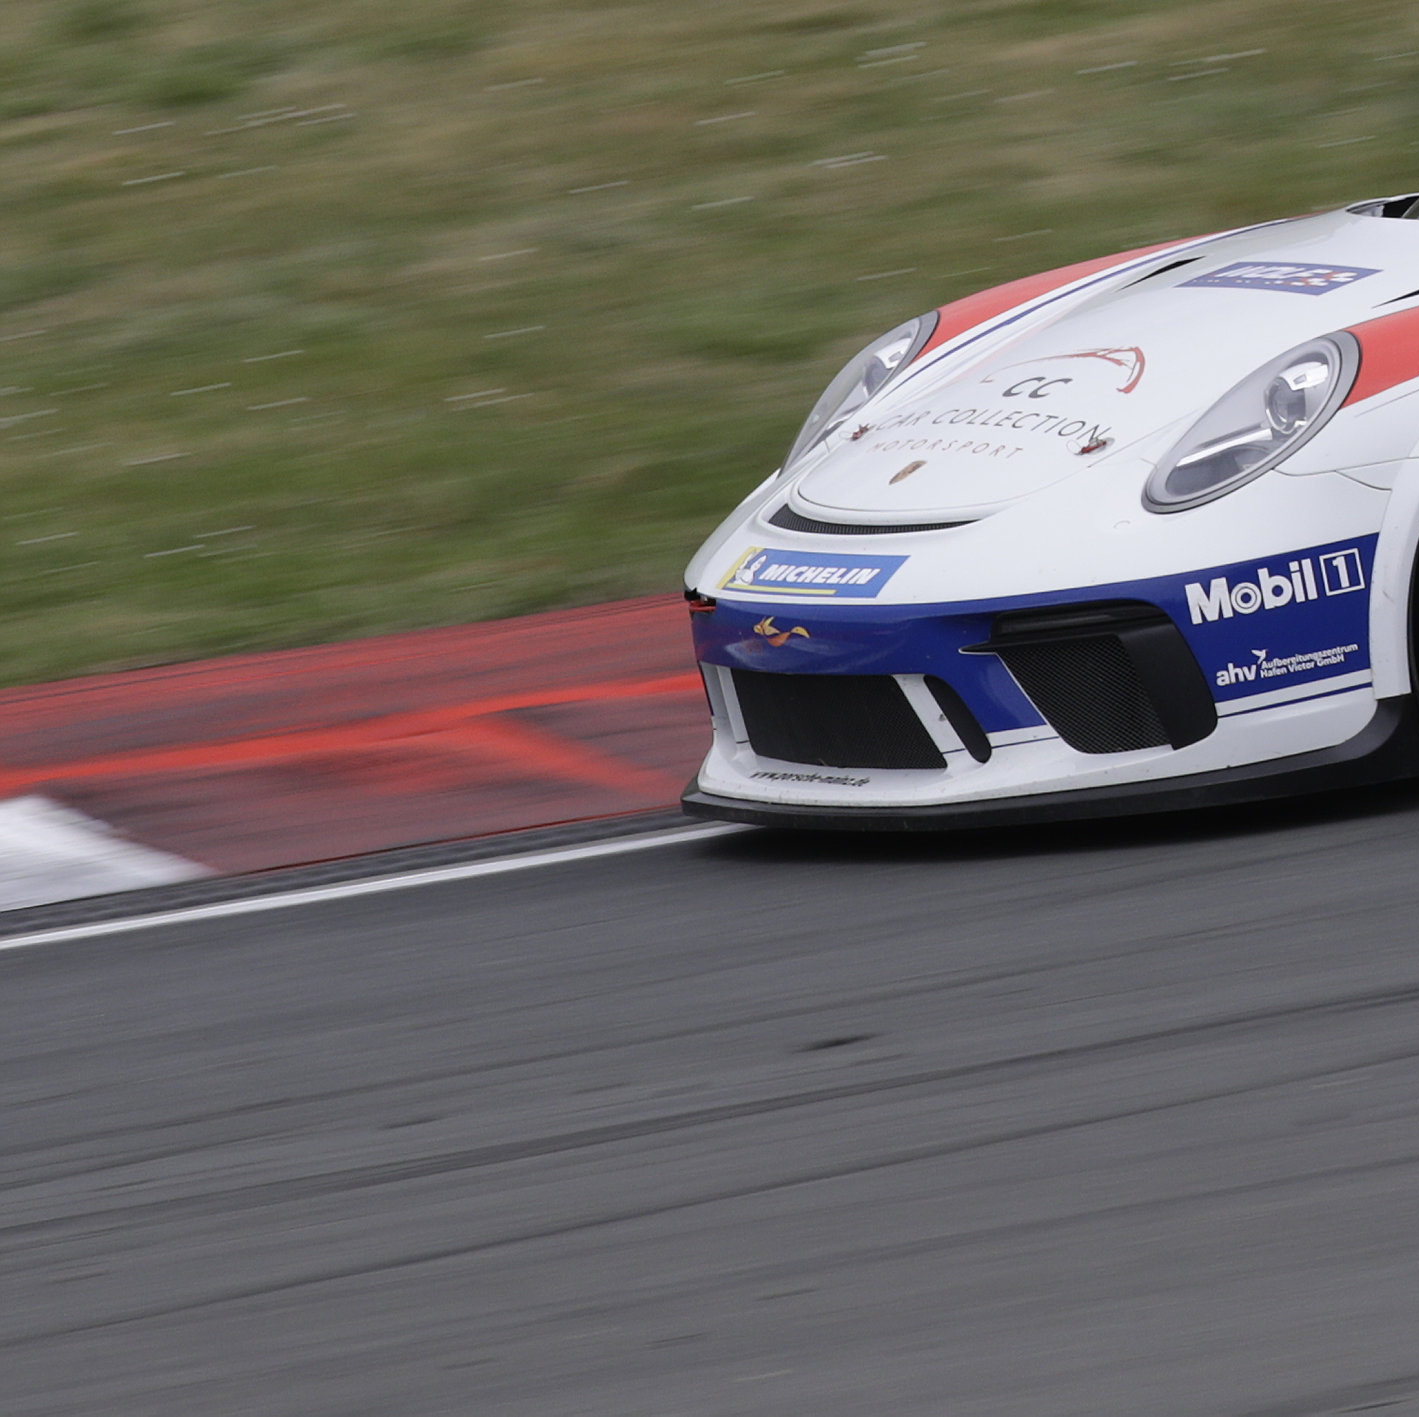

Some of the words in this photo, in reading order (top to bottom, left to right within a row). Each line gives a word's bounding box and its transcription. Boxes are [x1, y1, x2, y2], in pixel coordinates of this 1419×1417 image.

[1002, 377, 1074, 399] CC
[874, 410, 931, 433] CAR
[932, 409, 1112, 442] COLLECTION
[869, 439, 1023, 459] MOTORSPORT
[758, 564, 881, 585] MICHELIN
[1184, 557, 1319, 625] Mobil
[1260, 665, 1288, 678] Hafen
[1289, 660, 1315, 673] Victor
[1316, 654, 1345, 667] GmbH
[1261, 644, 1359, 669] Aufbereitungszentrum
[1216, 663, 1257, 686] ahv
